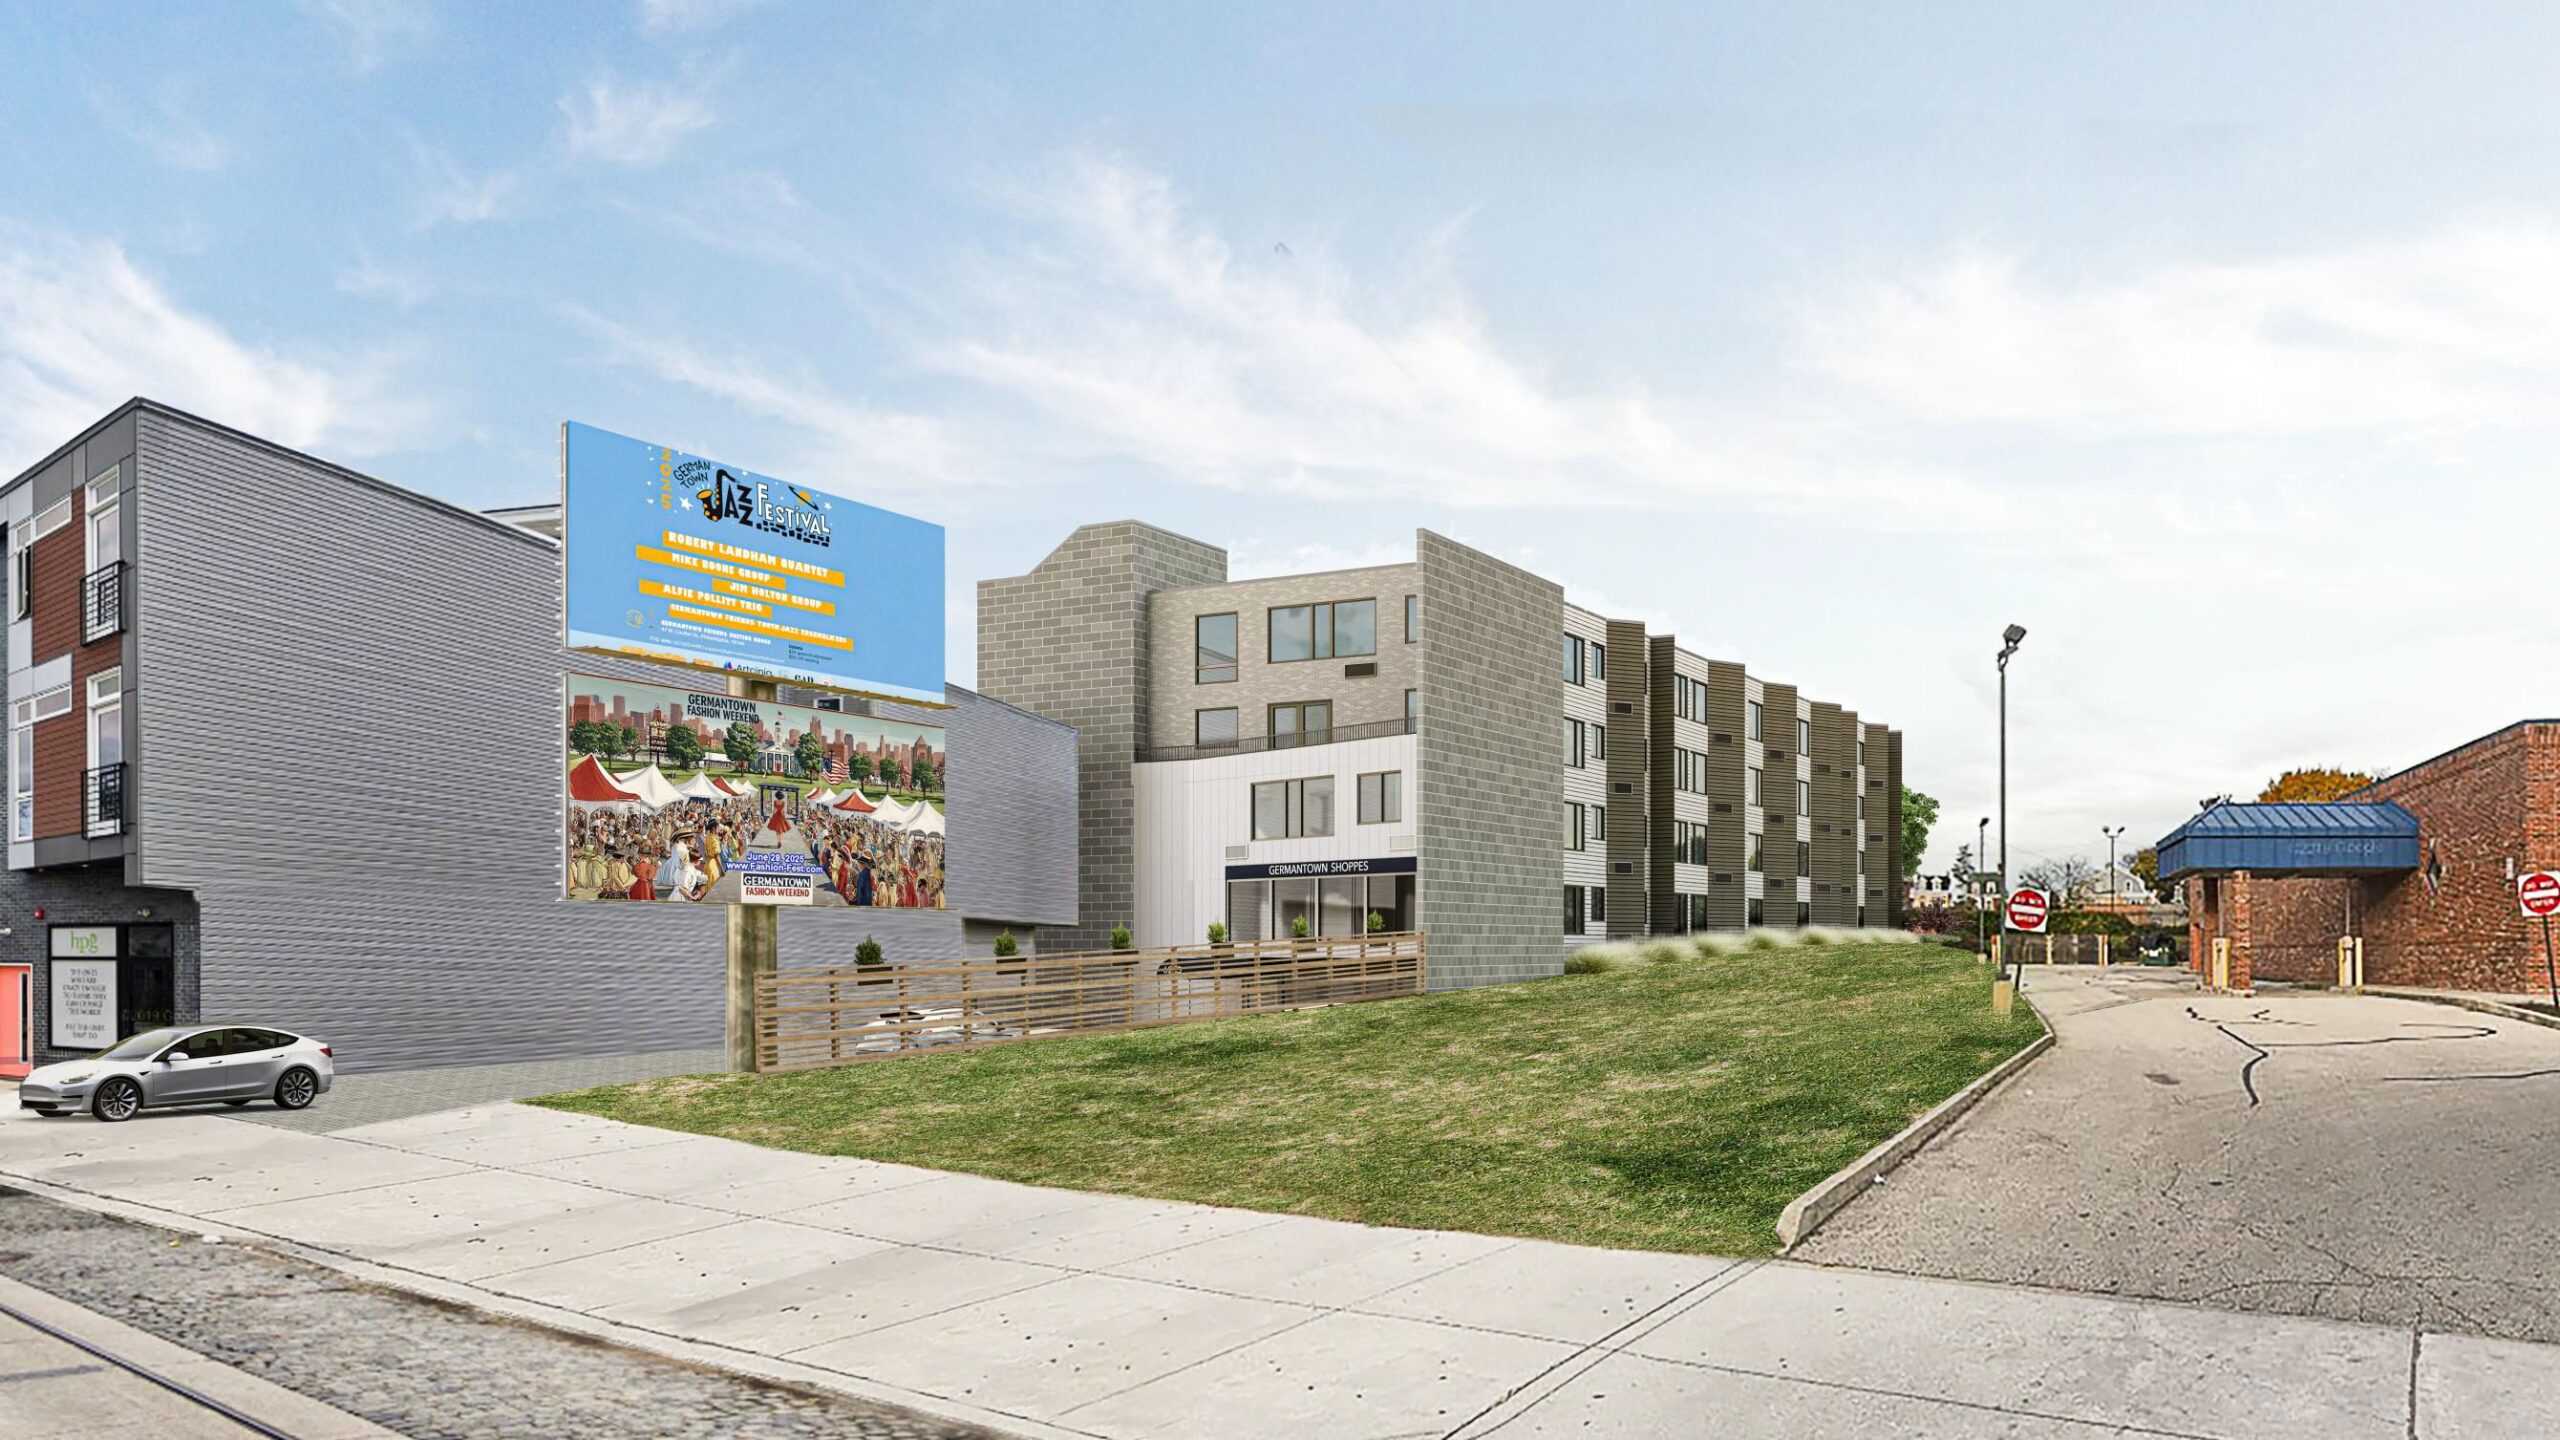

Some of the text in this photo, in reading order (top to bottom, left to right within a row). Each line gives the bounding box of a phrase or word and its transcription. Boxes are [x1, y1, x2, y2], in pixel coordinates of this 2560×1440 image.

[673, 459, 711, 481] GERMAN
[680, 472, 709, 488] TOWN
[668, 531, 714, 551] ROBERT
[780, 558, 829, 578] QUARTET
[671, 553, 698, 567] MIKE
[738, 566, 771, 582] GROUP
[663, 585, 694, 599] ALFIE
[740, 599, 763, 612] TRIO
[791, 594, 822, 609] GROUP
[688, 694, 756, 713] GERMANTOWN
[687, 704, 760, 724] FASHION WEEKEND
[747, 851, 768, 862] June
[785, 854, 805, 863] 2025
[726, 862, 823, 873] www.Fashion-Fest.com
[1269, 860, 1369, 875] GERMANTOWN SHOPPES
[744, 876, 810, 888] GERMANTOWN
[746, 887, 810, 897] FASHION WEEKEND
[70, 930, 99, 954] hpg
